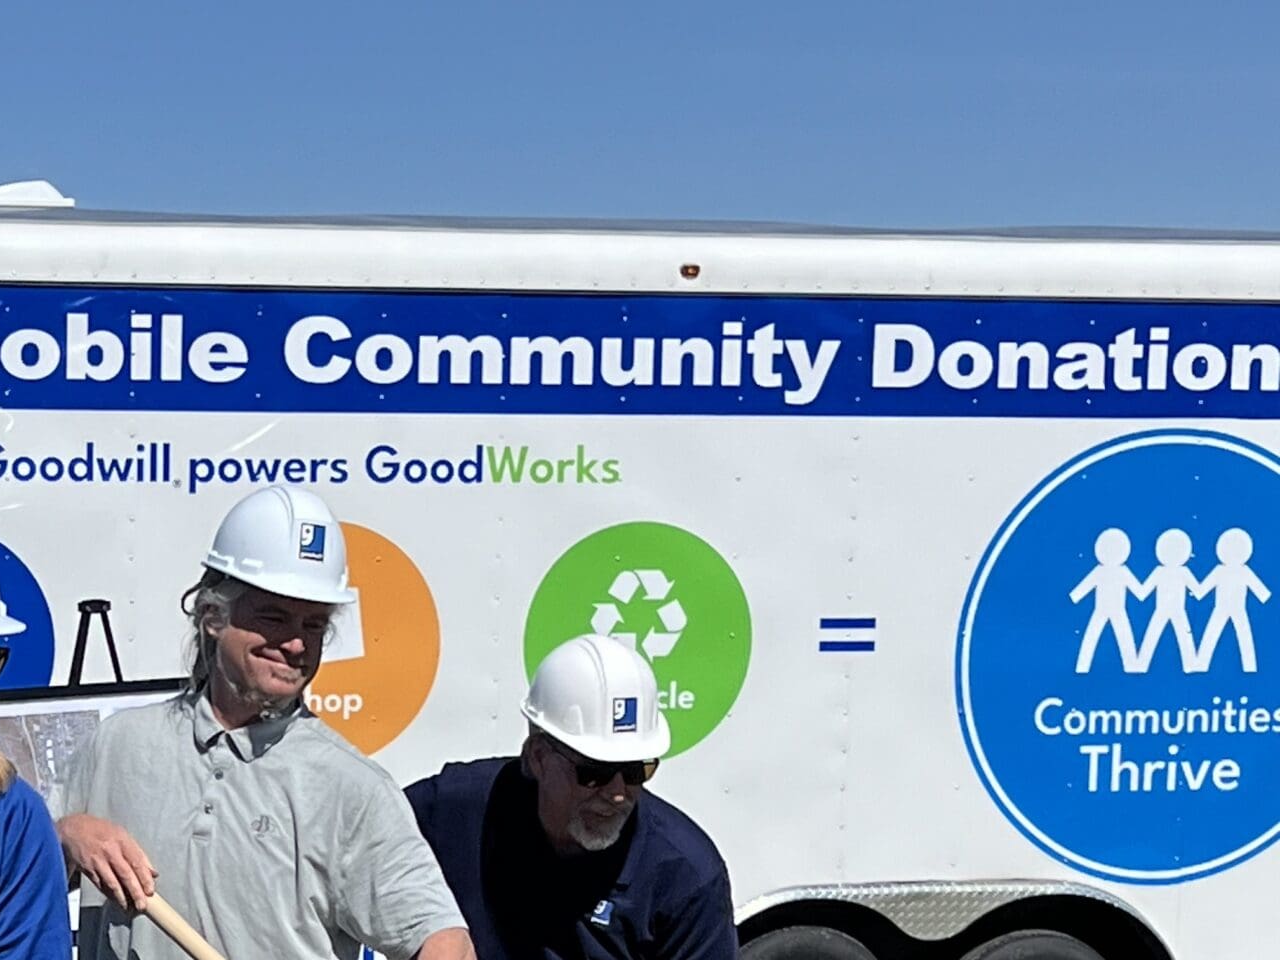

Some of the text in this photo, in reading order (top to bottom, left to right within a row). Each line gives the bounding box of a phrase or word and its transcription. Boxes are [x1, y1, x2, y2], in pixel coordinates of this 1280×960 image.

[284, 315, 841, 405] Community
[872, 323, 1280, 391] Donation
[188, 455, 349, 494] powers
[304, 683, 363, 720] hop
[657, 680, 695, 710] cle
[1034, 696, 1280, 735] Communities
[1079, 743, 1241, 792] Thrive
